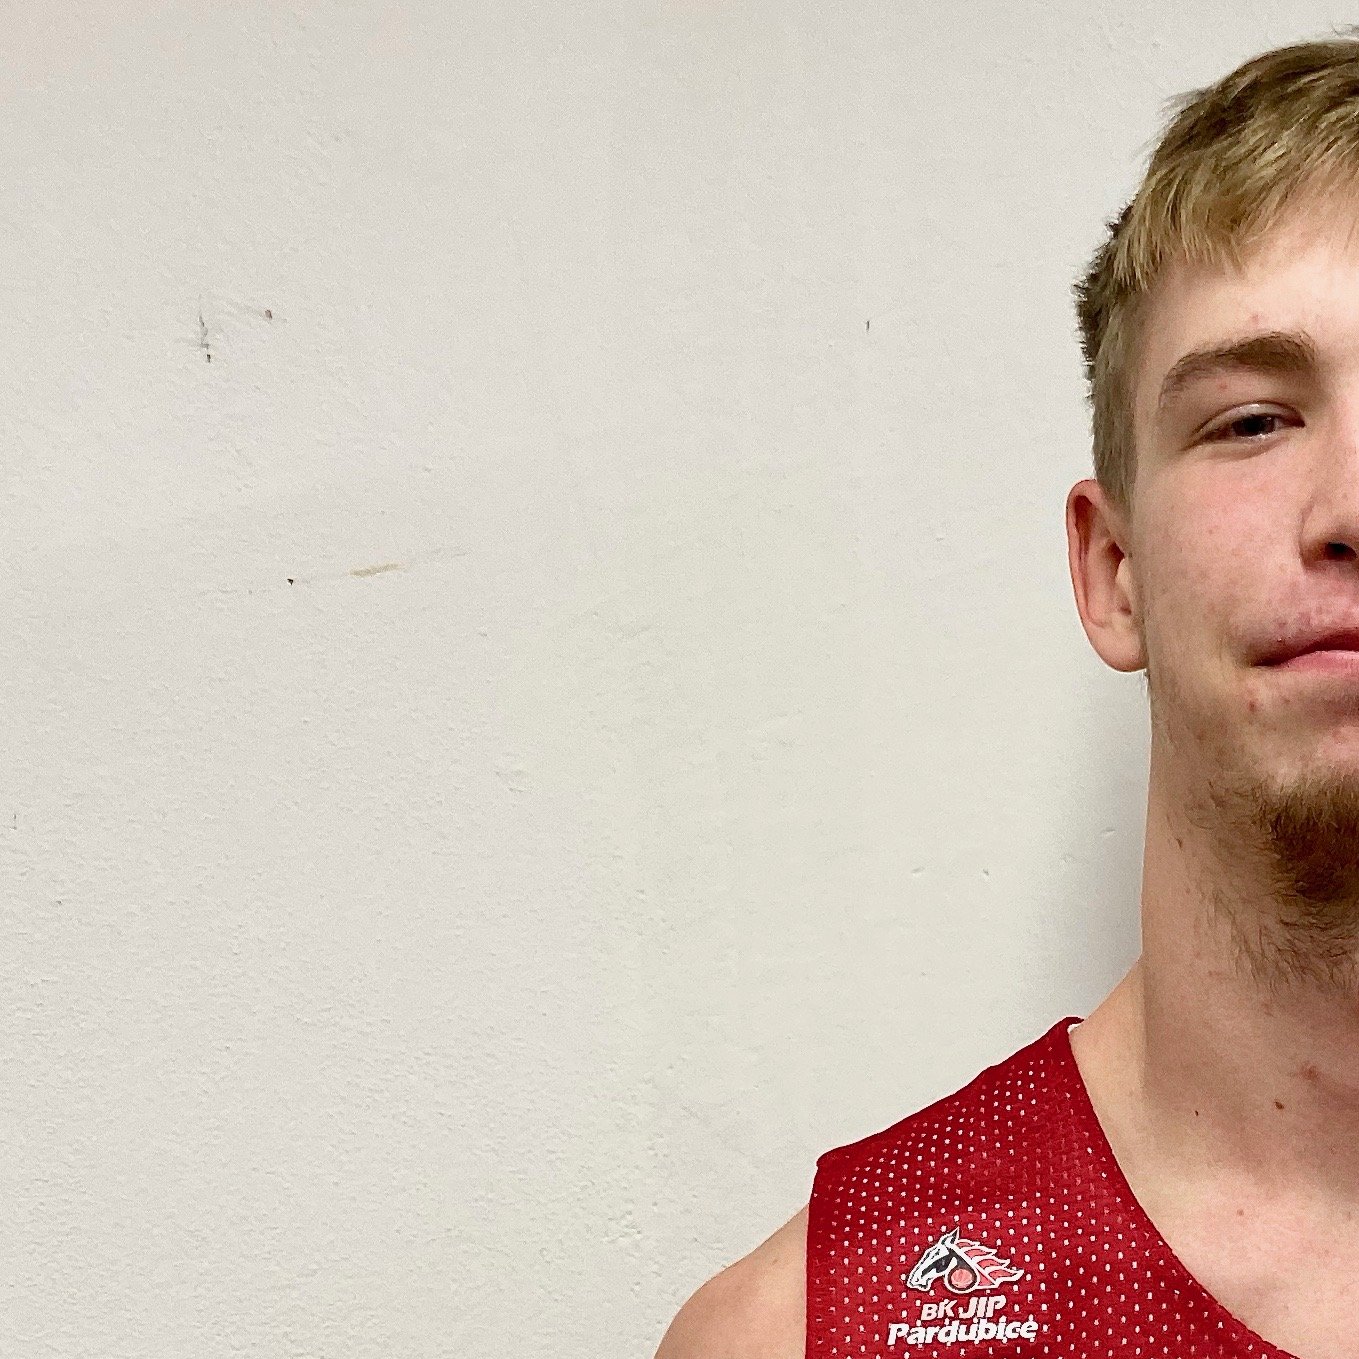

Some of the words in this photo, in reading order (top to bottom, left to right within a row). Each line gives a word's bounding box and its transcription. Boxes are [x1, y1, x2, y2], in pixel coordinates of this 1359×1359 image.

[920, 1300, 956, 1321] BK
[957, 1294, 1007, 1319] JIP
[887, 1318, 1039, 1346] Pardubice
